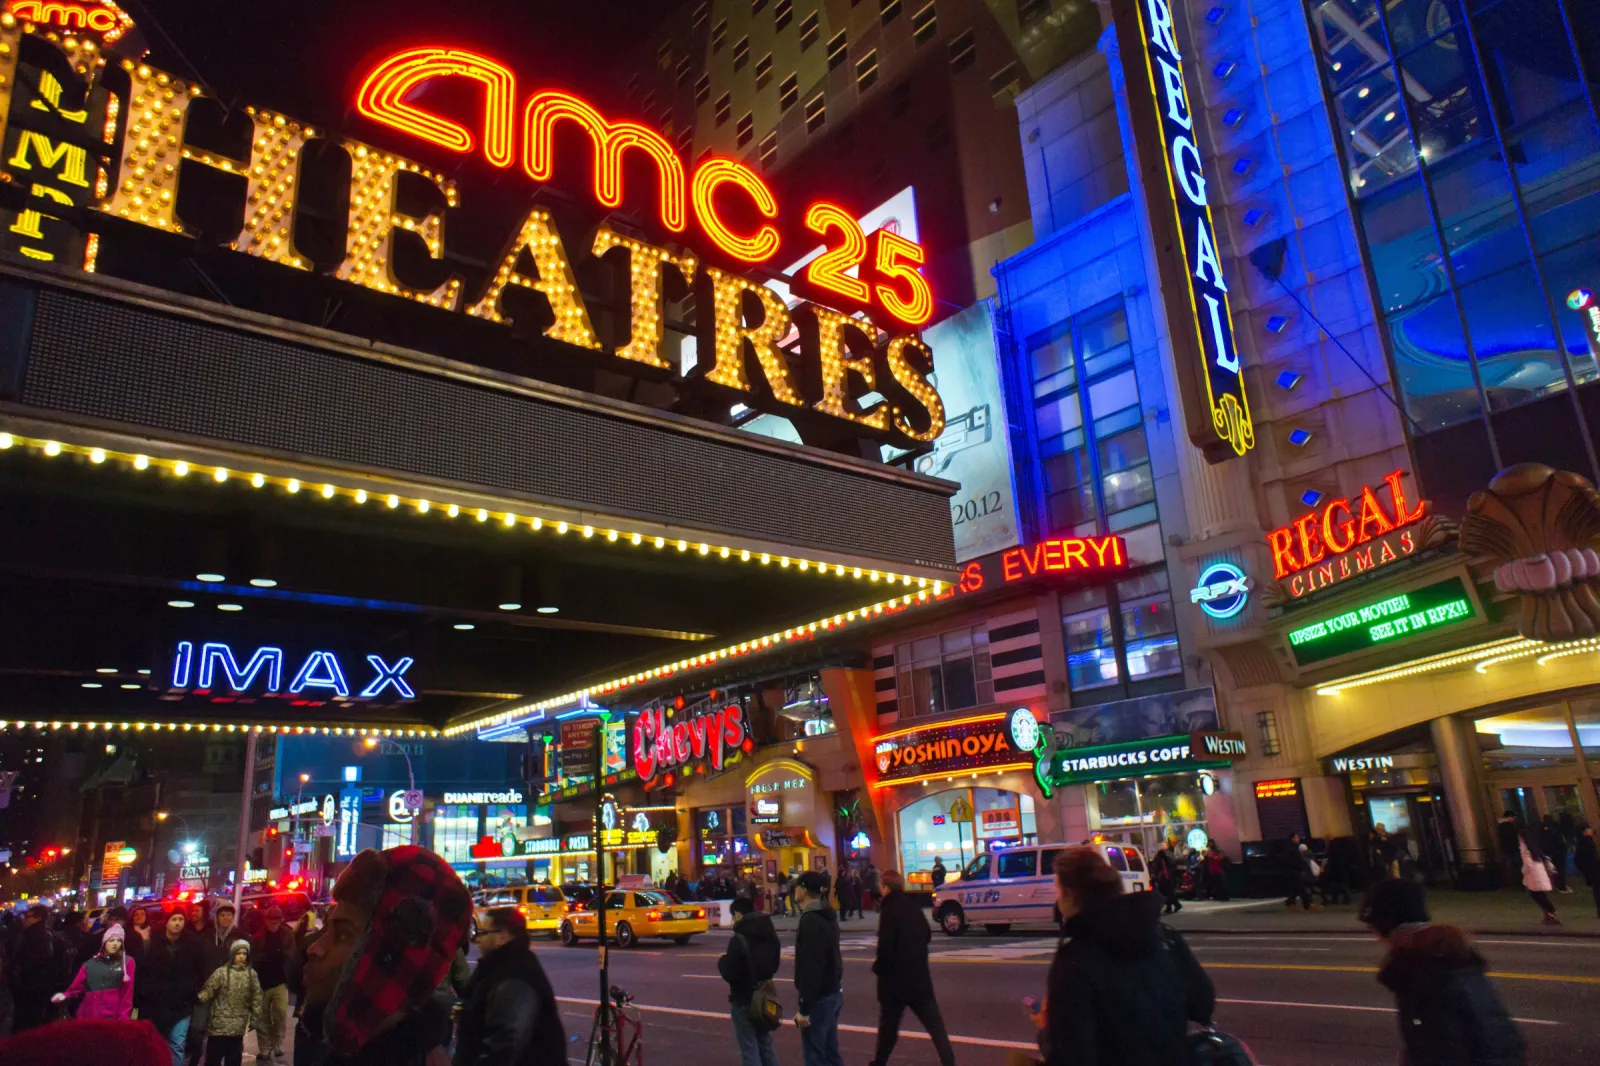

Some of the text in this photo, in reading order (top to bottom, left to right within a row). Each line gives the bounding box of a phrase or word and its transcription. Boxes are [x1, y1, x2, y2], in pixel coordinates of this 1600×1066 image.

[10, 1, 117, 31] amc
[354, 46, 935, 326] amc 25
[1145, 0, 1239, 375] REGAL
[953, 490, 1003, 527] 20.12
[1266, 468, 1425, 580] REGAL
[1290, 530, 1415, 598] CINEMAS
[1191, 575, 1249, 604] RPX
[1289, 594, 1411, 645] UPSIZE YOUR MOVIE!!
[1369, 599, 1469, 641] SEE IT IN RPX!!
[173, 641, 415, 698] IMAX
[633, 703, 745, 781] Chevys
[890, 730, 1011, 768] YOSHINOYA
[1062, 745, 1195, 773] STARBUCKS COFF
[1204, 735, 1246, 755] WESTIN
[1333, 755, 1393, 772] WESTIN
[751, 778, 805, 795] FRESH MEX
[181, 866, 210, 878] PARK
